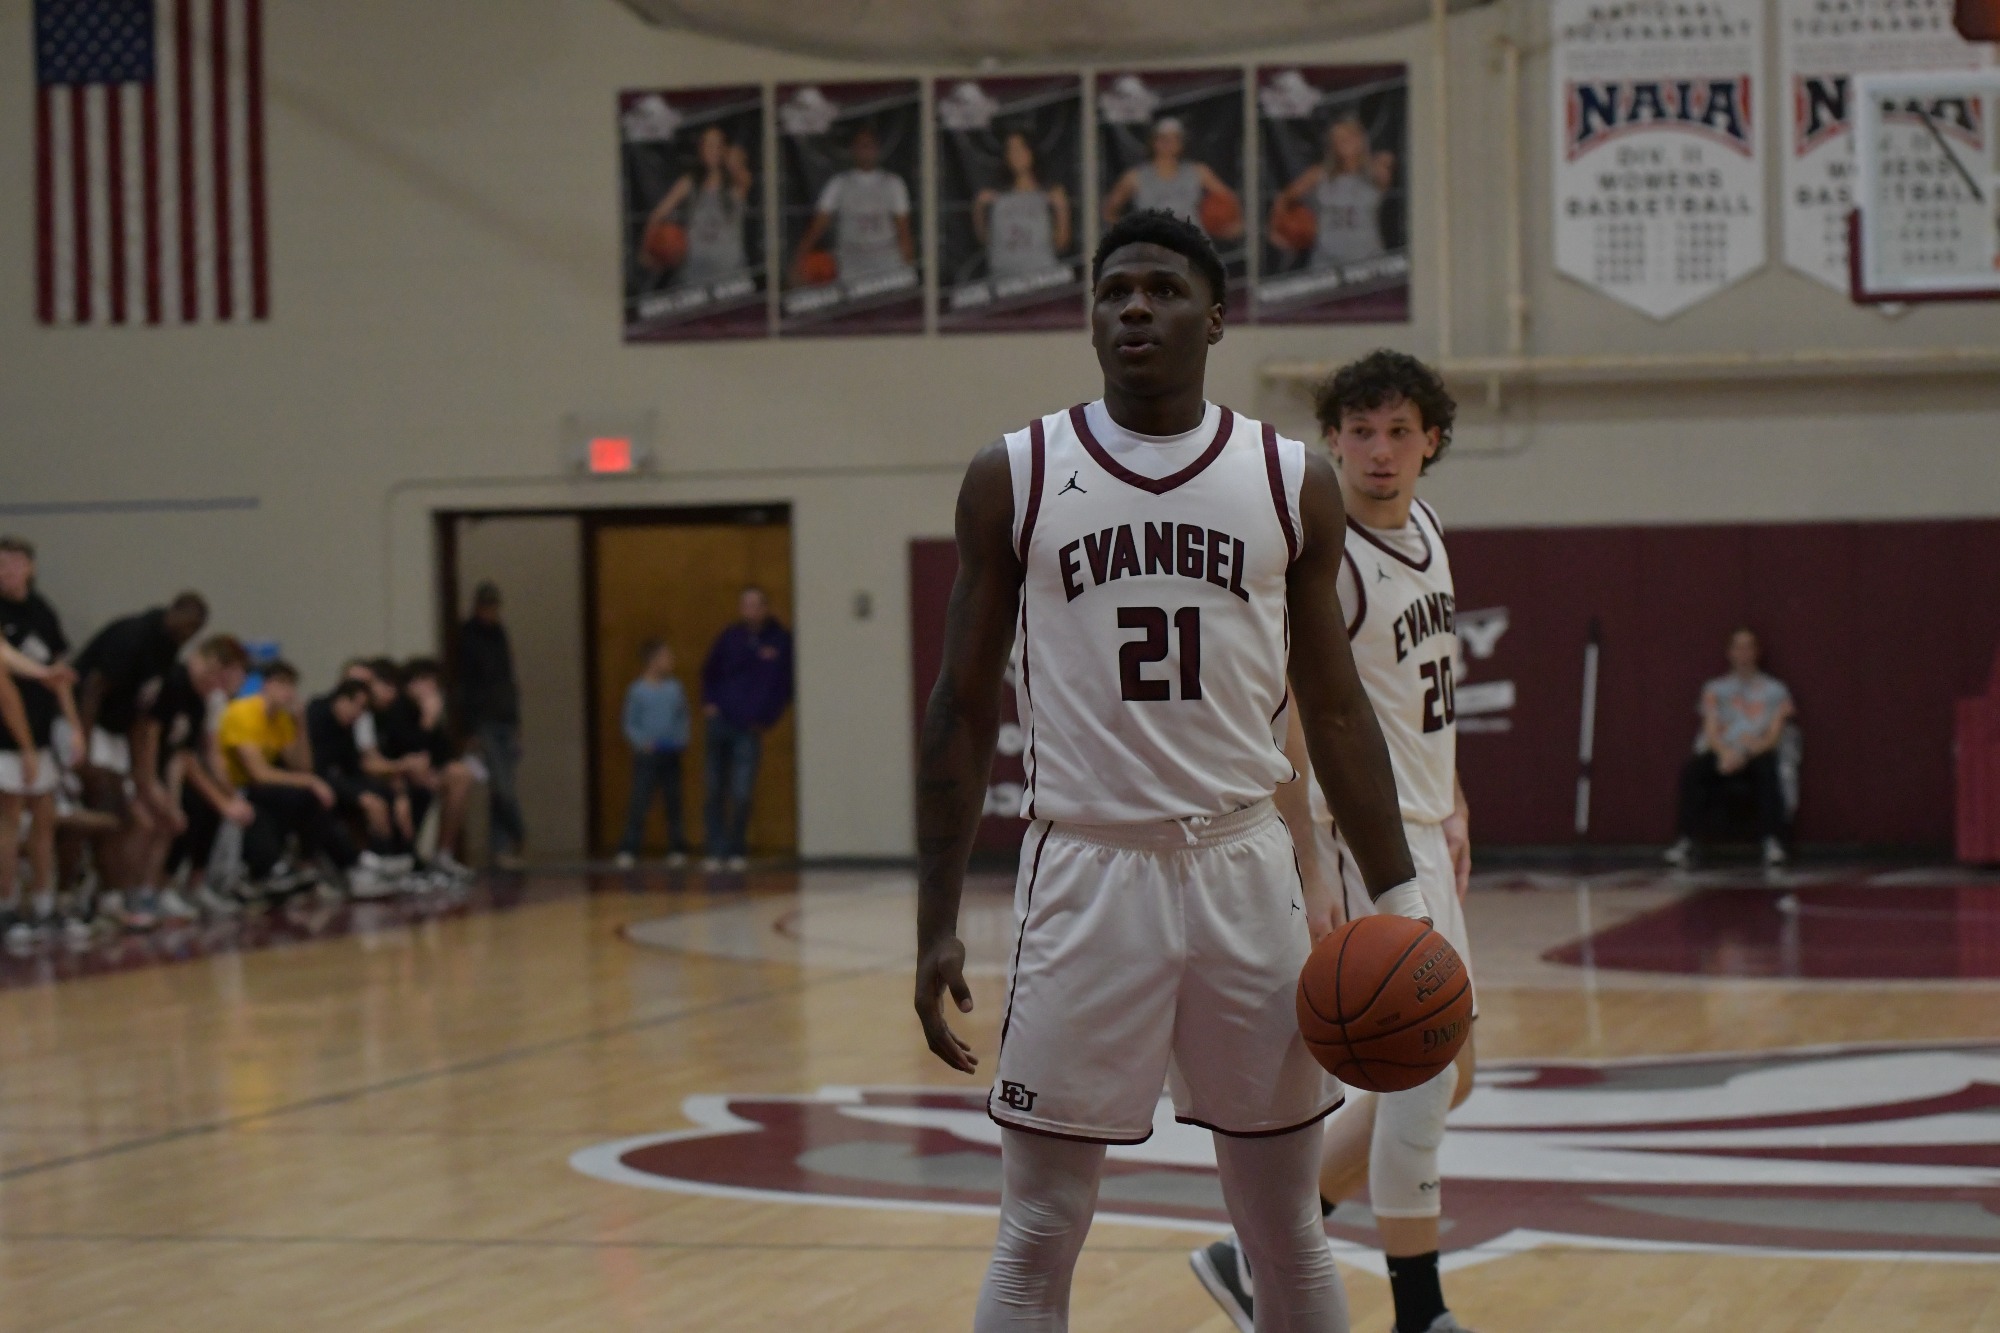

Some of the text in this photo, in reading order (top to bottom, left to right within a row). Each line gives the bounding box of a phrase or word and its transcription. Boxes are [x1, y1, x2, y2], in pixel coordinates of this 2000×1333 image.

[1577, 82, 1744, 141] NAIA
[1566, 197, 1752, 218] BASKETBALL
[1058, 521, 1250, 603] EVANGEL
[1116, 606, 1203, 701] 21
[1393, 592, 1456, 664] EVANG
[1419, 655, 1455, 734] 20
